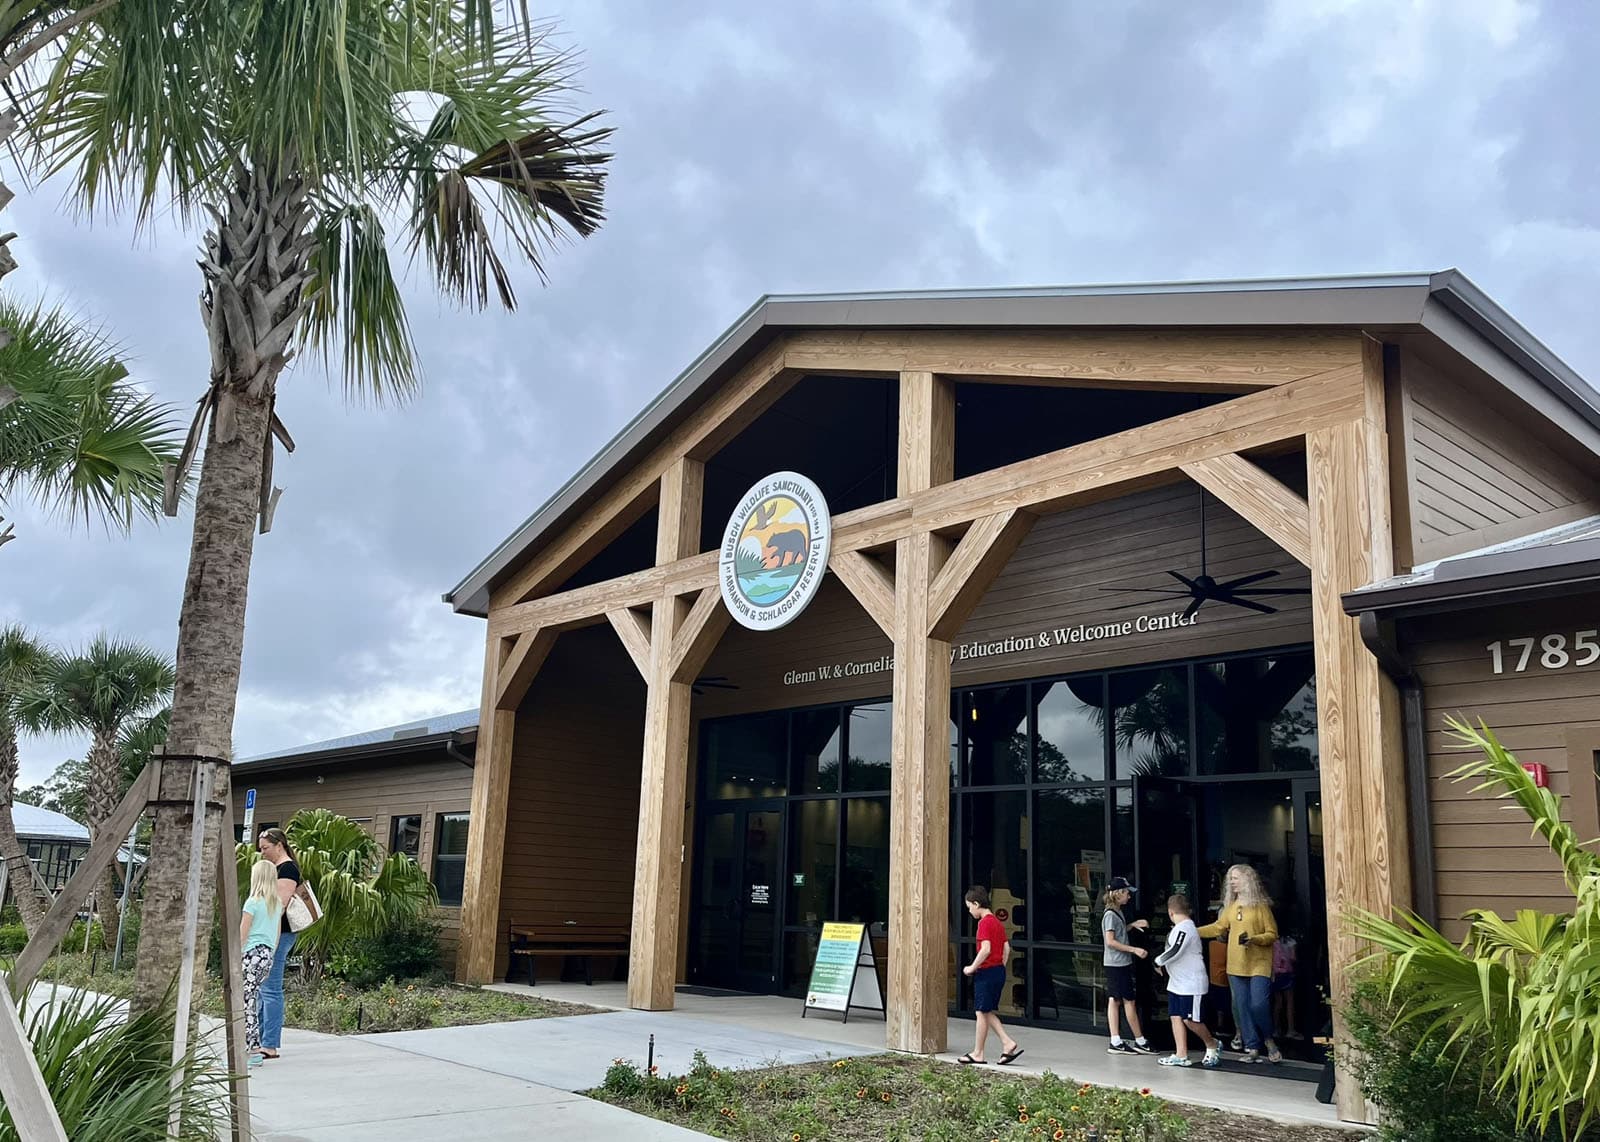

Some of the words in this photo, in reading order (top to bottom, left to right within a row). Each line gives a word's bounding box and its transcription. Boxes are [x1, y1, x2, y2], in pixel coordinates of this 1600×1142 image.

[725, 522, 740, 559] BUSCH
[738, 486, 770, 520] WILDLIFE
[772, 480, 812, 506] SANCTUARY
[725, 574, 751, 616] ABRAMSON
[749, 610, 756, 620] &
[758, 592, 801, 621] SCHLAGGAR
[801, 543, 820, 591] RESERVE
[783, 670, 816, 685] Glenn
[818, 666, 832, 680] W.
[833, 664, 843, 677] &
[845, 656, 895, 676] Cornelia
[960, 635, 1035, 660] Education
[1038, 631, 1051, 648] &
[1054, 620, 1132, 645] Welcome
[1136, 611, 1198, 633] Center
[1486, 629, 1600, 674] 1785
